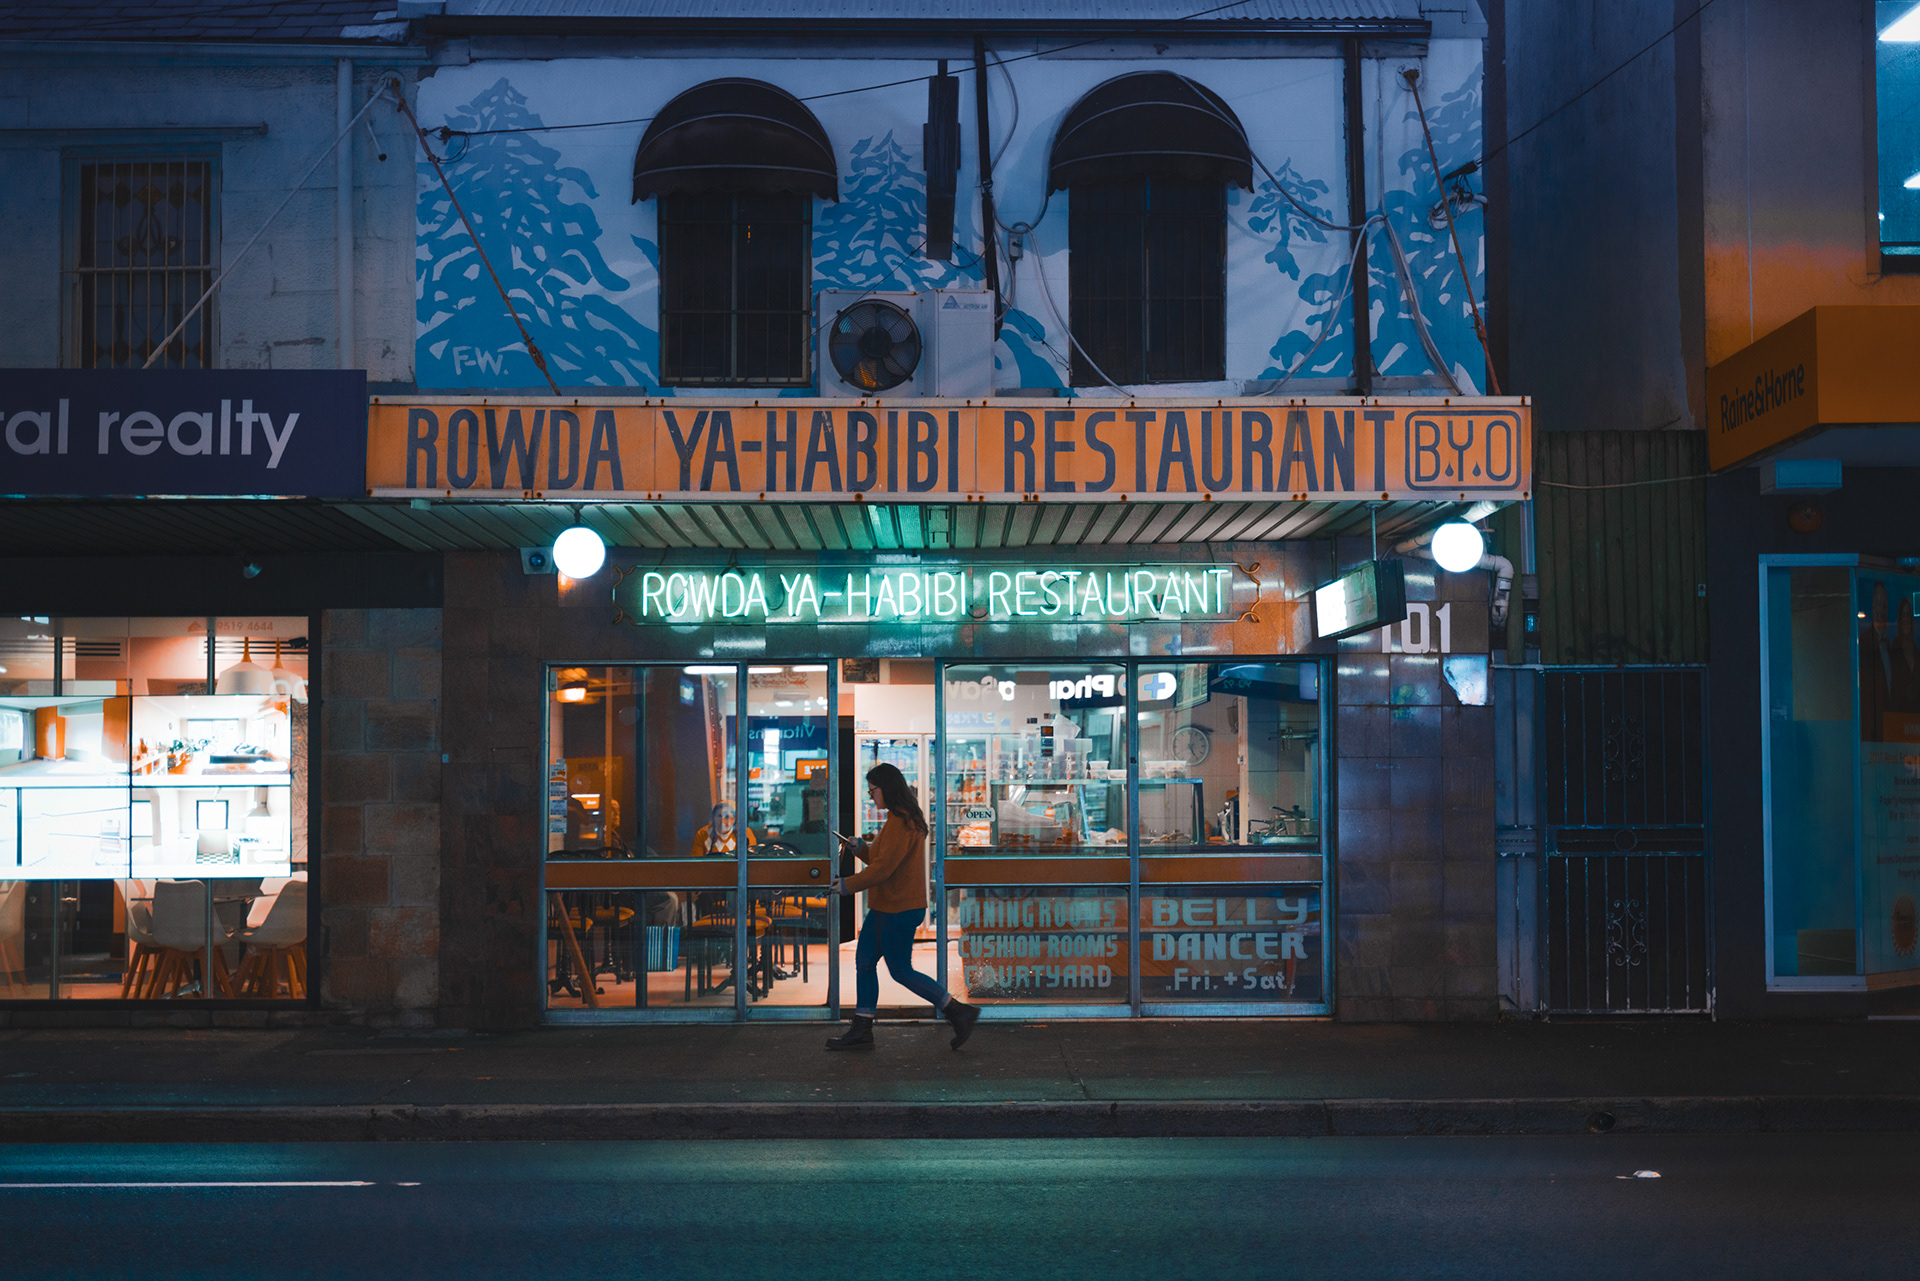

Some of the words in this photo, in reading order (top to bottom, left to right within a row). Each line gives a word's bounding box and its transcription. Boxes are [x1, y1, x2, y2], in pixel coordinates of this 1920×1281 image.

[0, 398, 70, 455] al
[98, 399, 300, 469] realty
[405, 408, 625, 491] ROWDA
[662, 410, 960, 493] YA-HABIBI
[1003, 409, 1396, 493] RESTAURANT
[642, 572, 769, 618] ROWDA
[779, 572, 966, 617] YA-HABIBI
[988, 569, 1229, 616] RESTAURANT
[216, 621, 243, 631] 9519
[247, 621, 274, 631] 4644
[966, 811, 992, 819] OPEN
[960, 900, 1034, 928] DINING
[1039, 901, 1116, 928] ROOMS
[1152, 898, 1308, 926] BELLY
[957, 935, 1041, 958] CUSHION
[1047, 935, 1118, 958] ROOMS
[1152, 932, 1309, 961] DANCER
[964, 965, 1112, 989] COURTYARD
